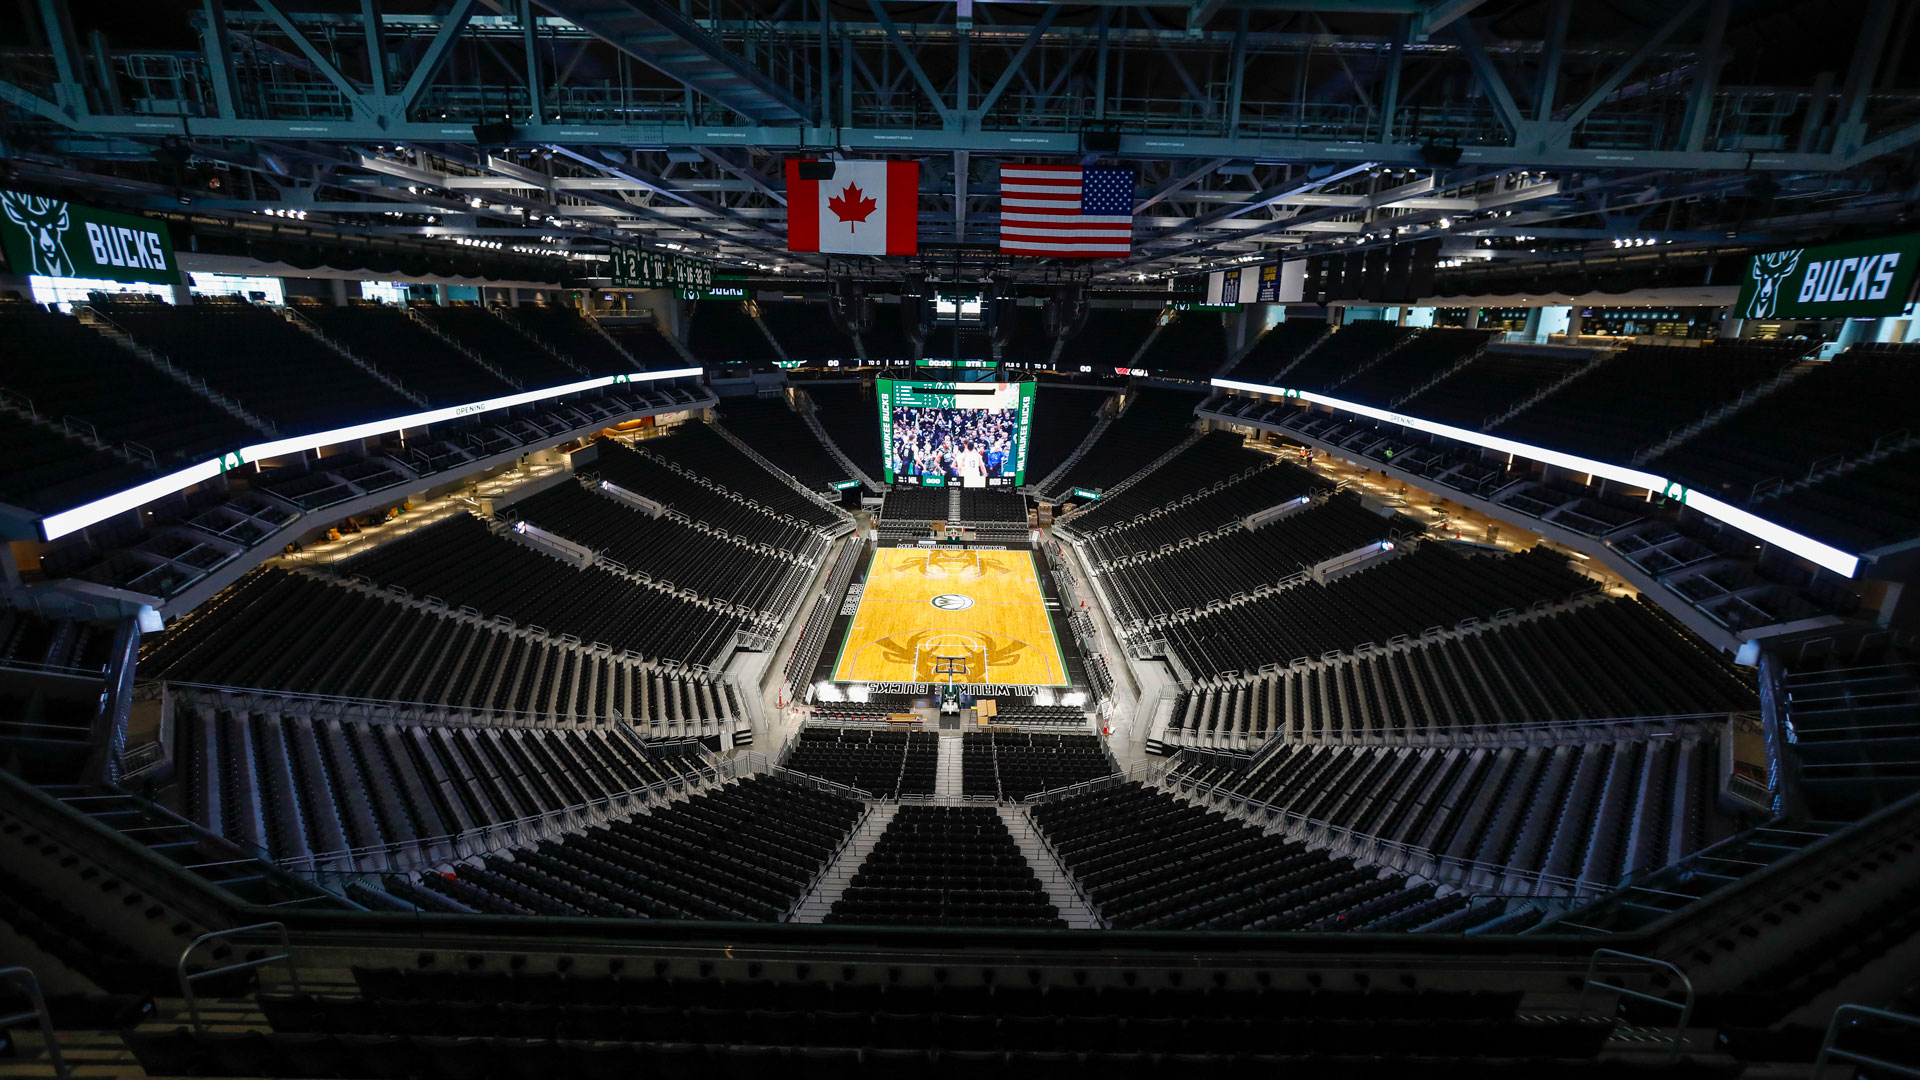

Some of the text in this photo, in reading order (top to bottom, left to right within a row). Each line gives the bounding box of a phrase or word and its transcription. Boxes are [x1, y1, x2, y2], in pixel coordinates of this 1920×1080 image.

[84, 221, 167, 270] BUCKS
[615, 255, 620, 276] 1
[629, 257, 636, 278] 2
[643, 259, 649, 279] 4
[654, 260, 663, 280] 10
[676, 264, 684, 282] 14
[686, 266, 694, 283] 16
[1797, 252, 1901, 303] BUCKS
[881, 393, 890, 422] BUCKS
[1020, 396, 1031, 425] BUCKS
[868, 682, 1039, 697] MILWAUKE BUCKS
